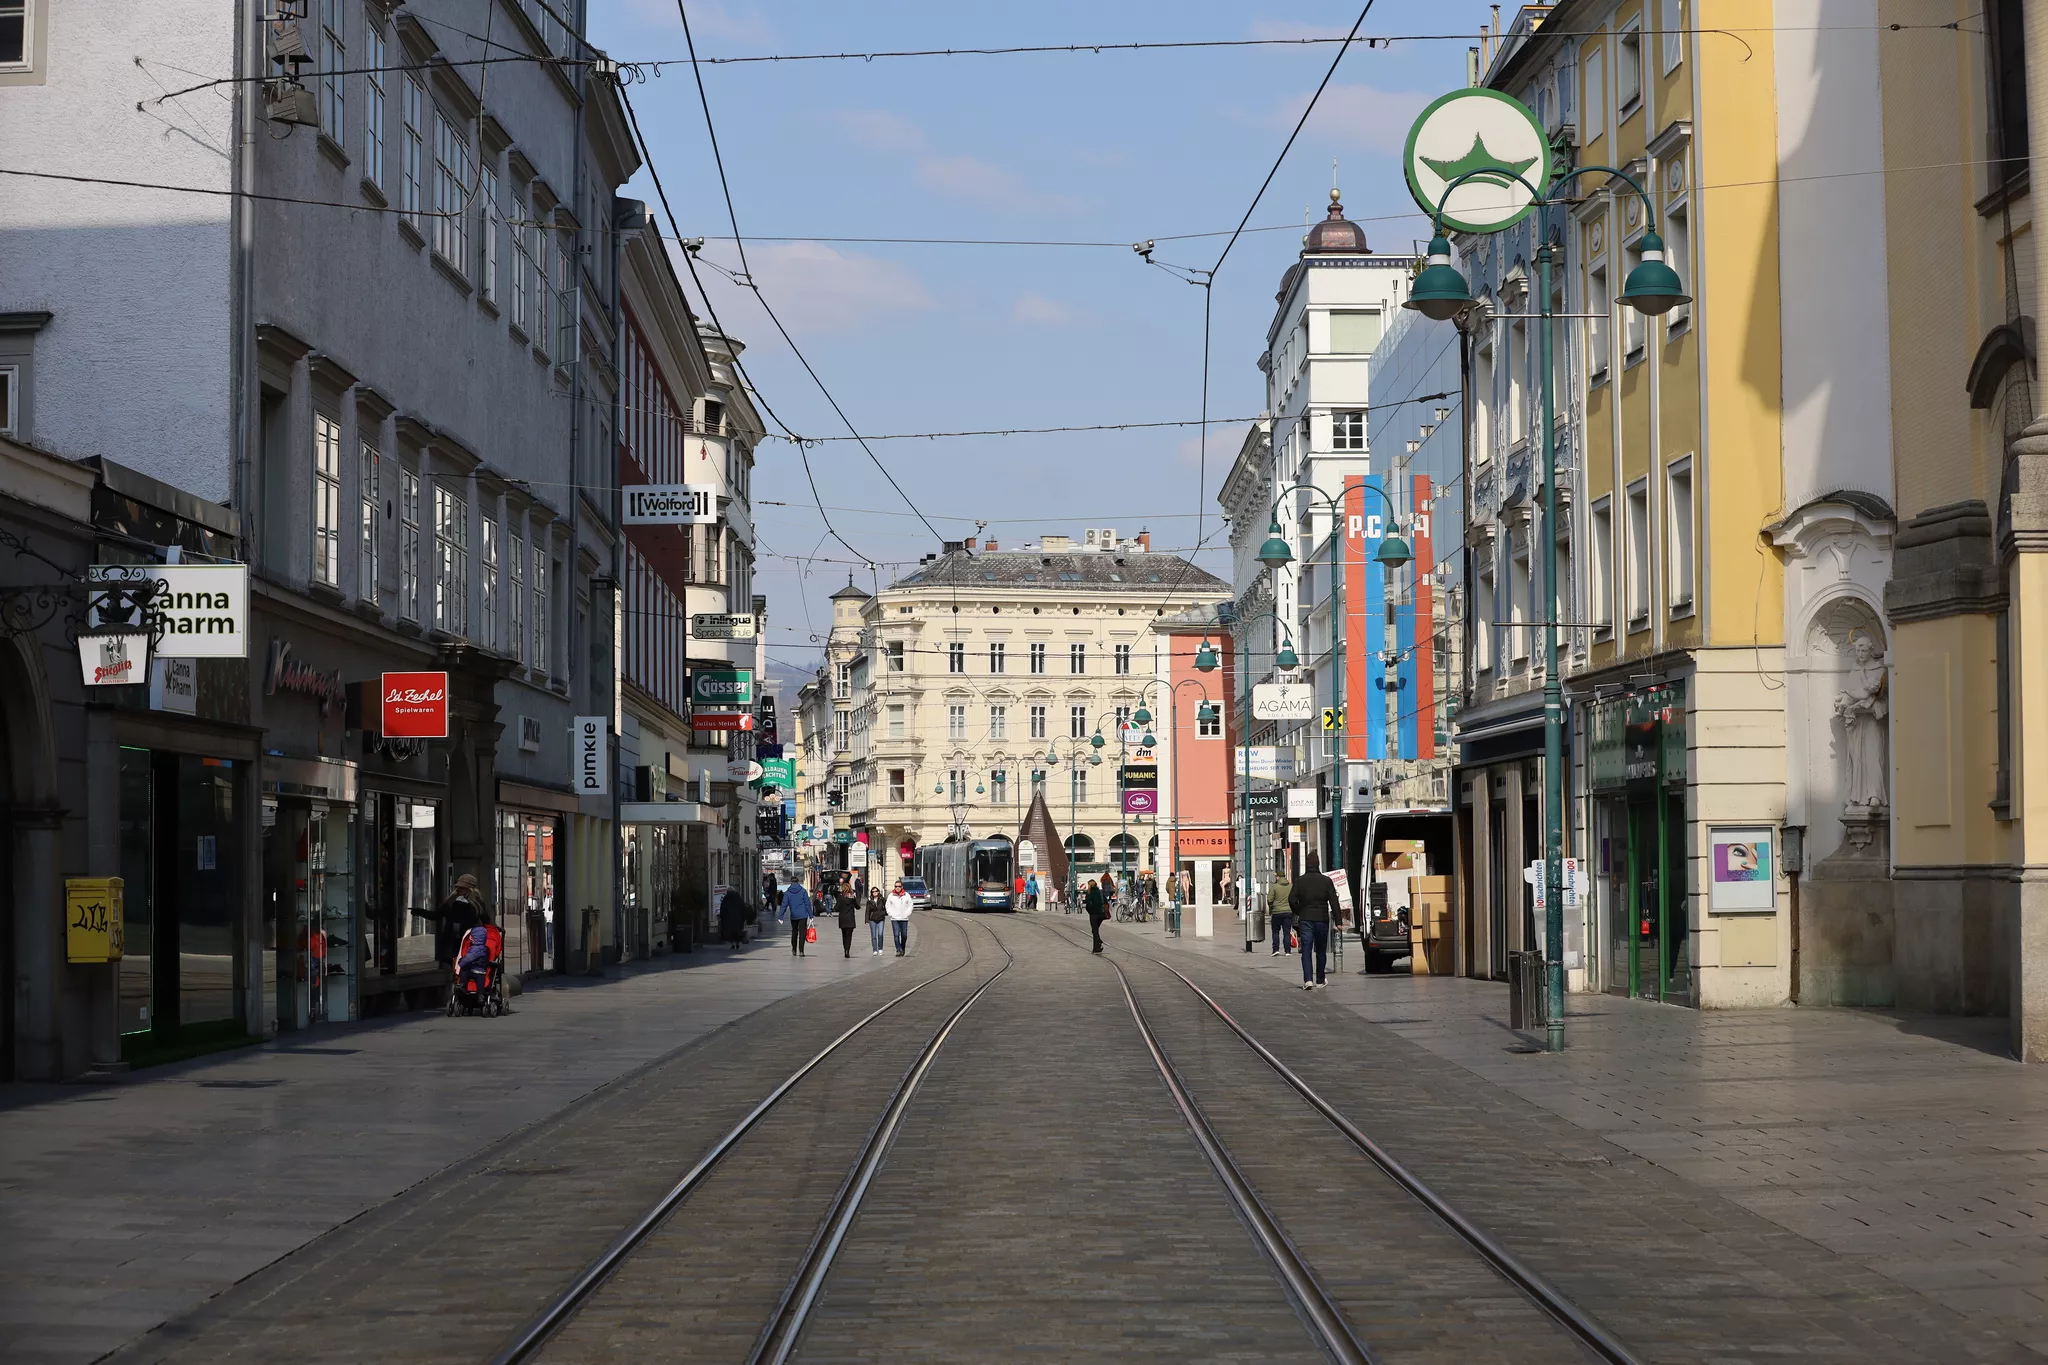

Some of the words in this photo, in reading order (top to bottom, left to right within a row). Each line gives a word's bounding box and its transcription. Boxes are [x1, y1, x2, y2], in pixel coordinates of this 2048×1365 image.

[643, 498, 695, 511] Wolford
[709, 615, 751, 626] inlingua
[695, 628, 752, 639] Sprachschule
[172, 659, 190, 677] Canna
[172, 677, 192, 696] Pharm
[697, 675, 749, 697] Gösser
[1257, 700, 1311, 712] AGAMA
[583, 722, 600, 789] pimkie
[1136, 748, 1152, 757] dm
[728, 766, 760, 779] Triumph
